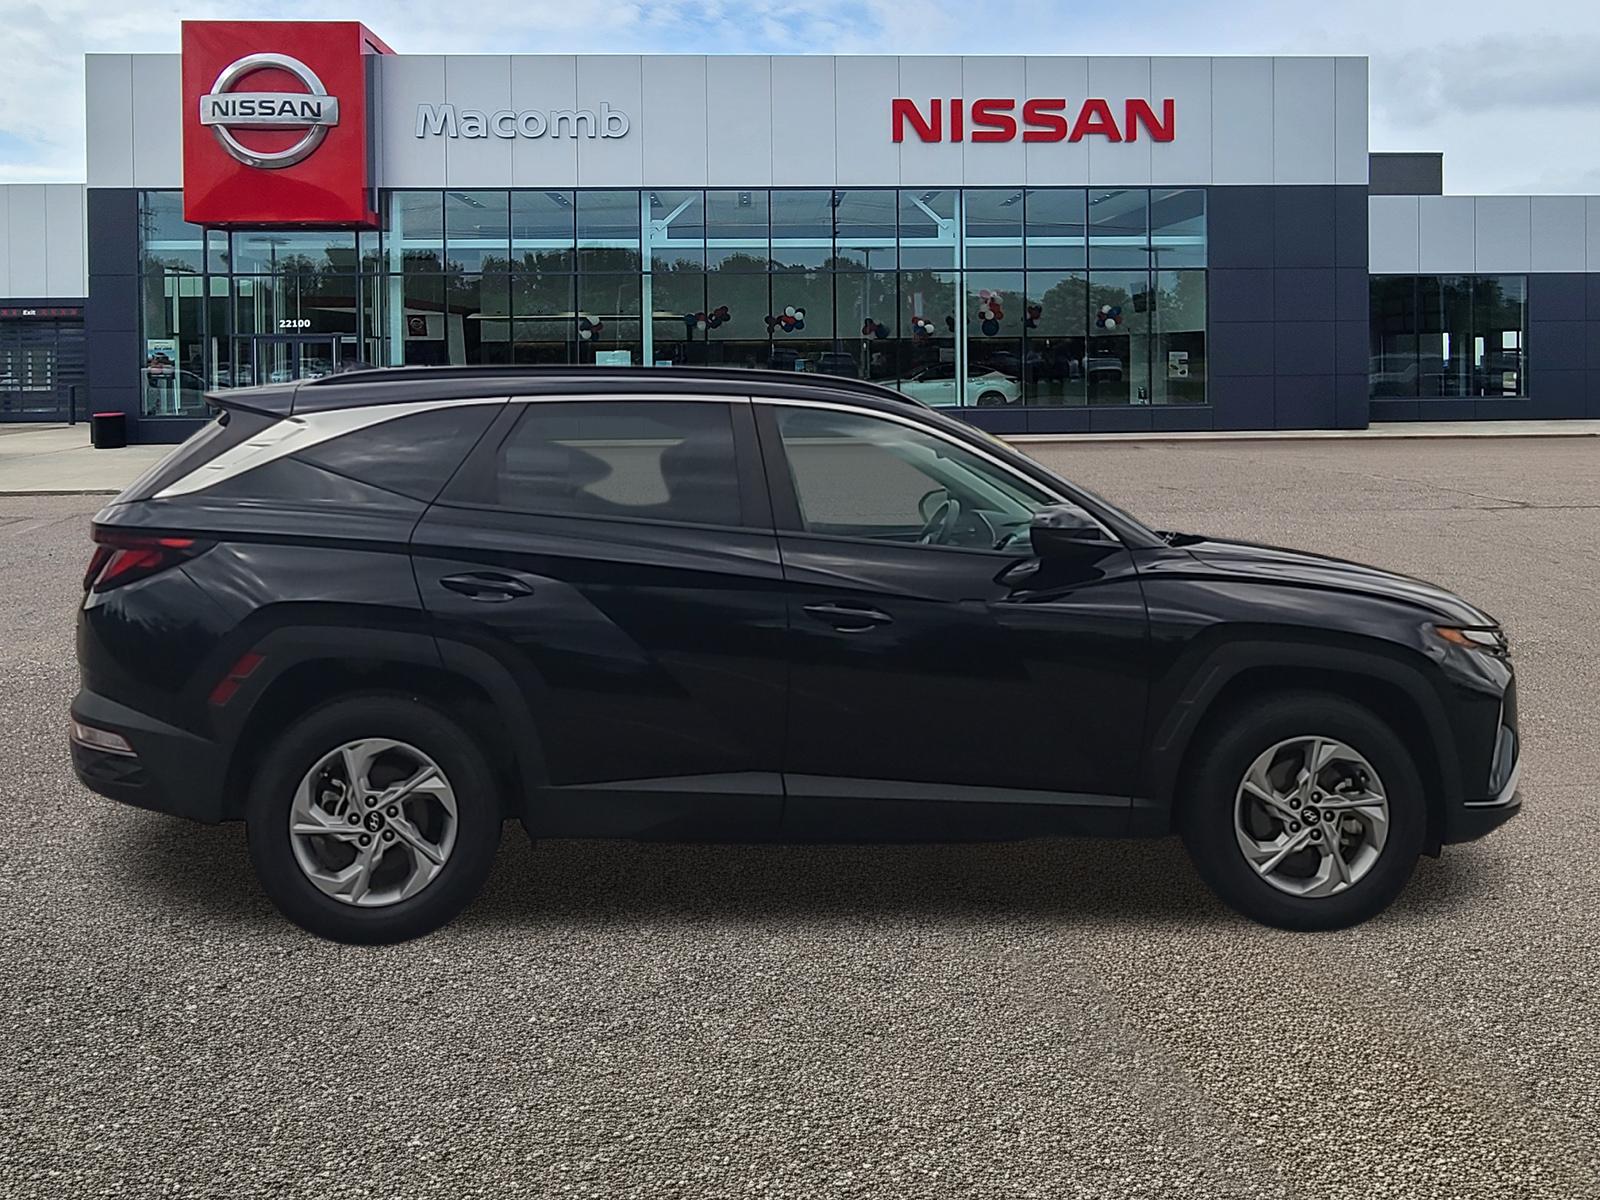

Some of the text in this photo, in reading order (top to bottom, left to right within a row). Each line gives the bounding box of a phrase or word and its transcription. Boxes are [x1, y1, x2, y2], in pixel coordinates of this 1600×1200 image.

[211, 100, 322, 117] NISSAN
[415, 101, 630, 139] Macomb
[892, 98, 1175, 143] NISSAN
[279, 319, 311, 328] 22100
